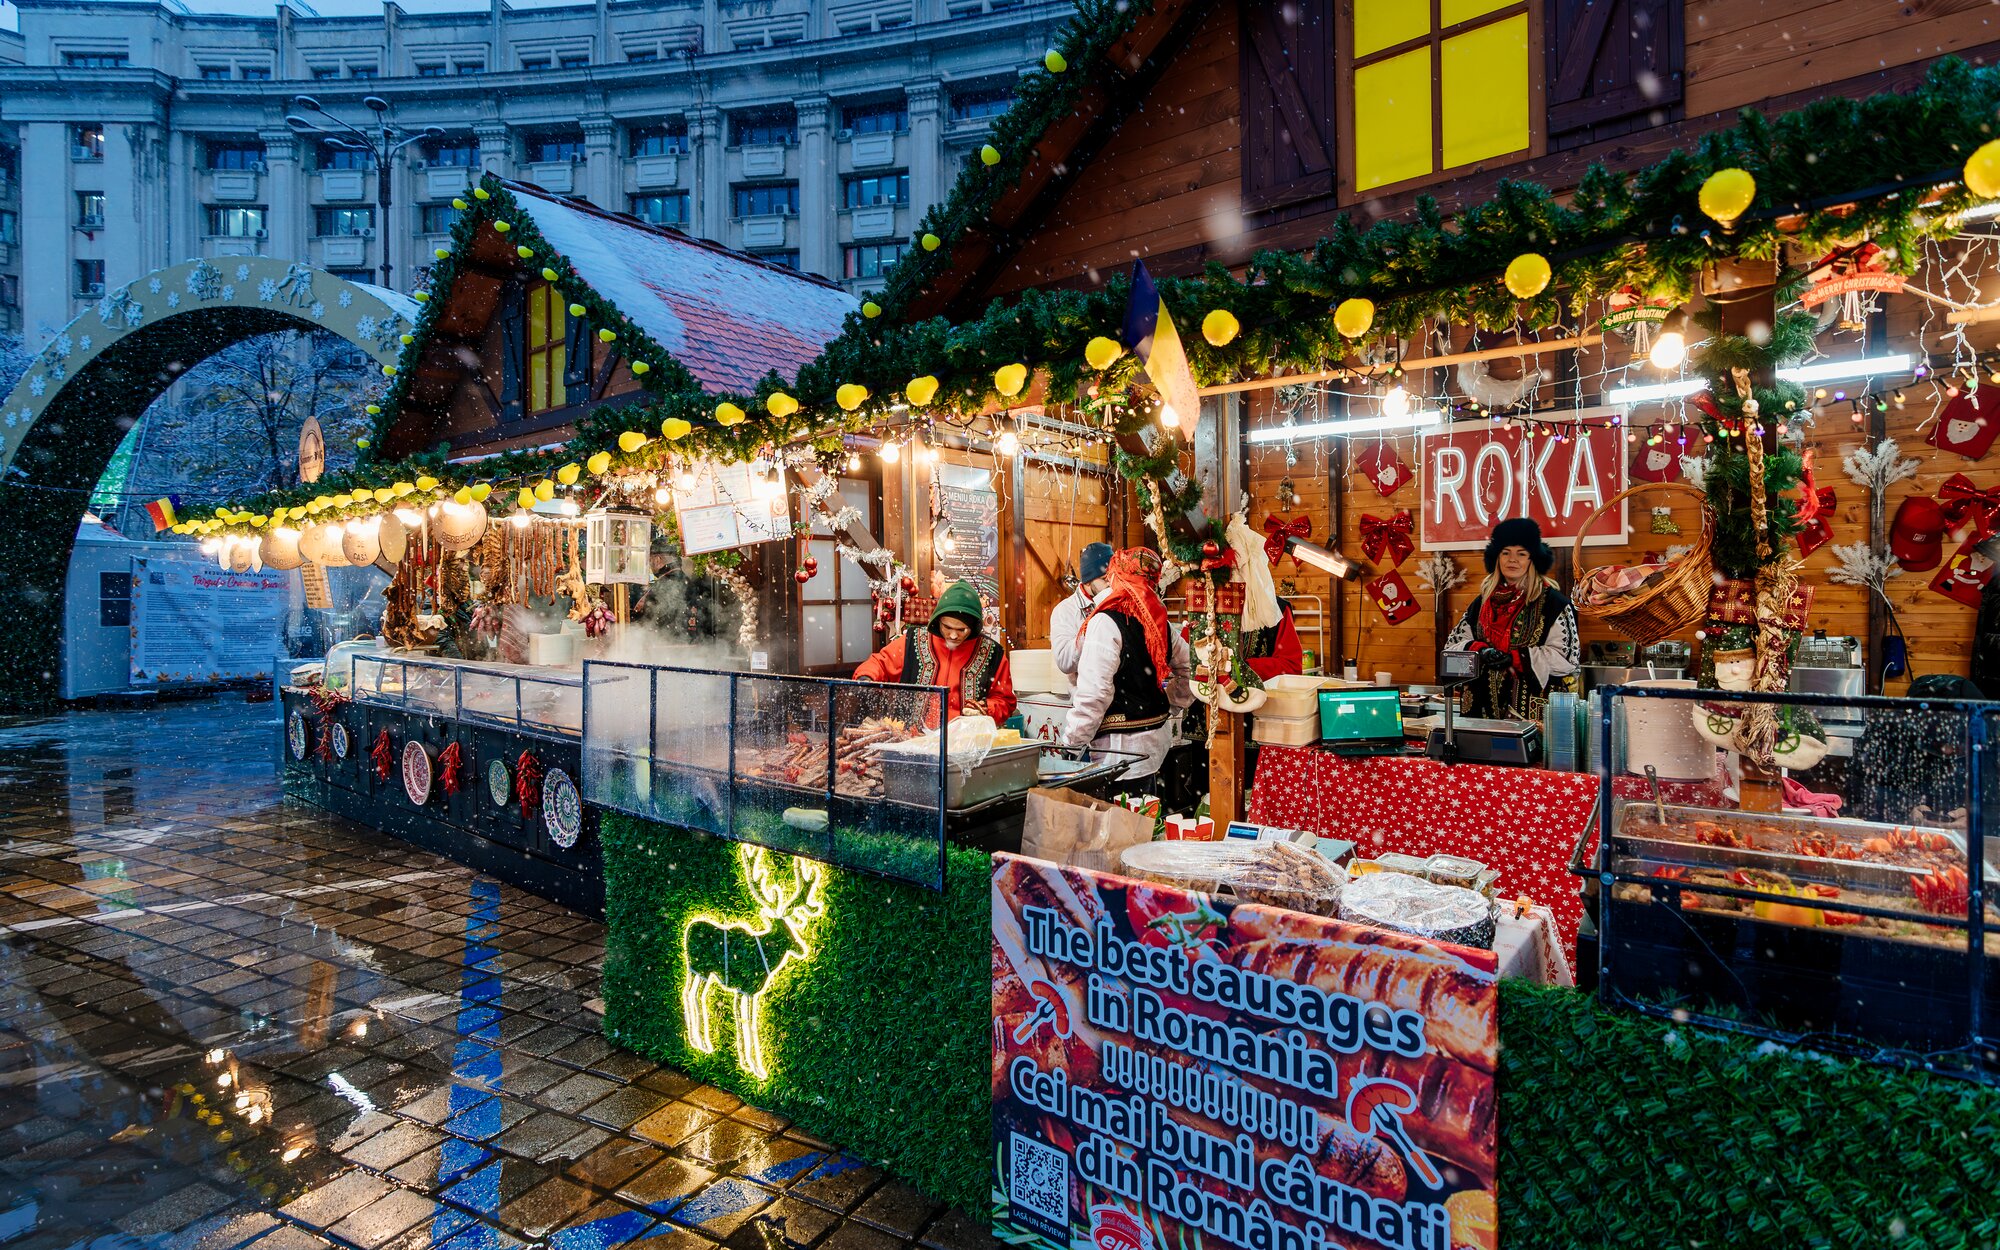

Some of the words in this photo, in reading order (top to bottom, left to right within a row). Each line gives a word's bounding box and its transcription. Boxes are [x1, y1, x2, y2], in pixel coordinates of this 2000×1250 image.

[1613, 310, 1633, 323] MERRY
[1634, 309, 1669, 318] CHRISTMAS
[1818, 282, 1842, 298] MERRY
[1844, 277, 1888, 290] CHRISTMAS
[948, 491, 968, 503] MENIU
[1434, 436, 1604, 528] ROKA
[1024, 906, 1092, 966] The
[1098, 922, 1187, 993] best
[1193, 960, 1426, 1057] sausages
[1088, 974, 1128, 1031] in
[1134, 988, 1337, 1098] Romania
[1011, 1056, 1067, 1116] Cei
[1072, 1086, 1146, 1147] mai
[1152, 1102, 1254, 1190] buni
[1077, 1133, 1142, 1201] din
[1028, 1216, 1039, 1227] UN
[1039, 1221, 1067, 1241] REVIEW!
